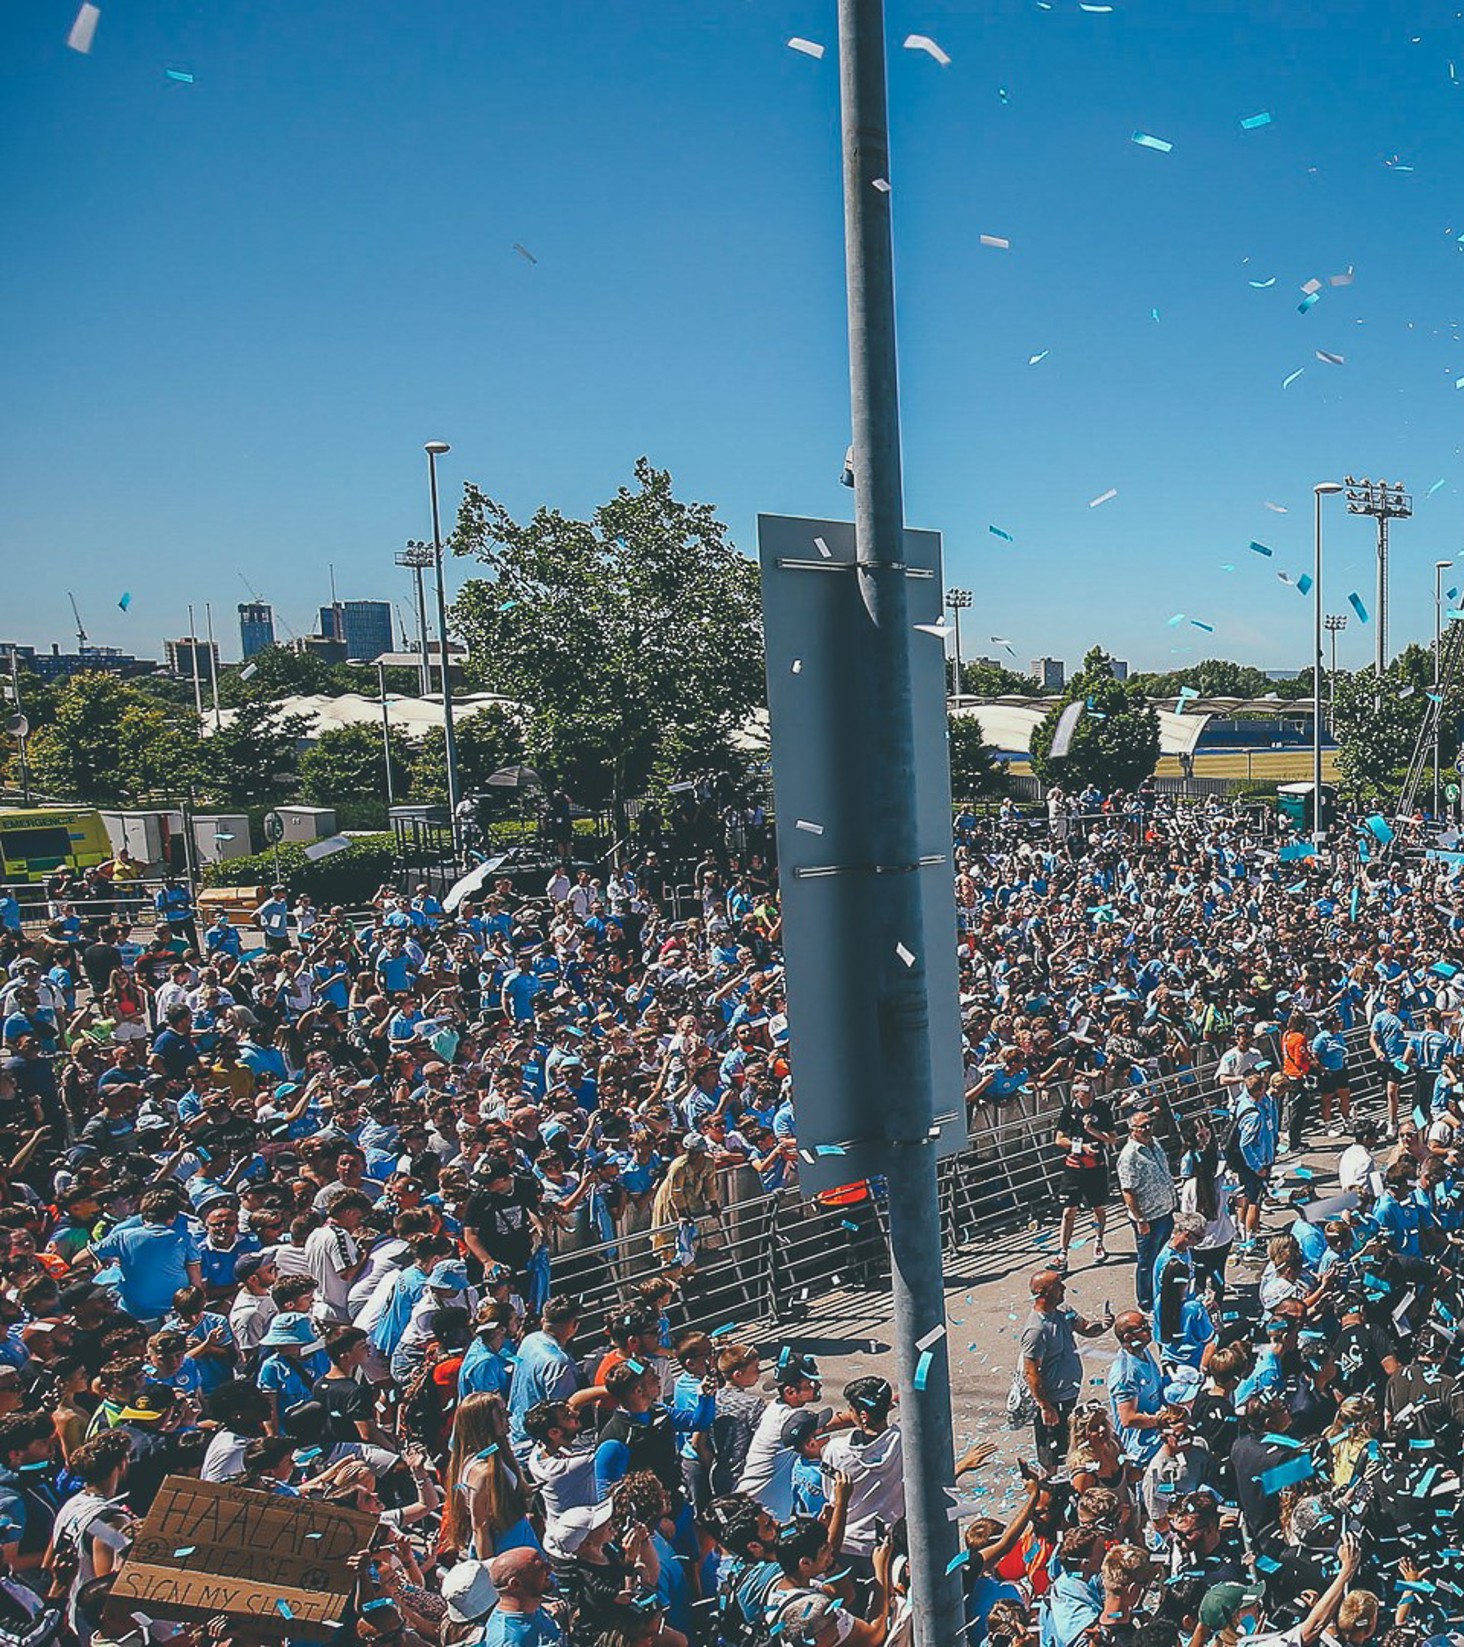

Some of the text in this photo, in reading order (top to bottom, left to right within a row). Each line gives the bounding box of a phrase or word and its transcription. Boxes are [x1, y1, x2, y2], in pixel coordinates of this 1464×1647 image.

[159, 1488, 357, 1562] HAALAND
[126, 1572, 193, 1606] SIGN
[197, 1585, 241, 1611] MY
